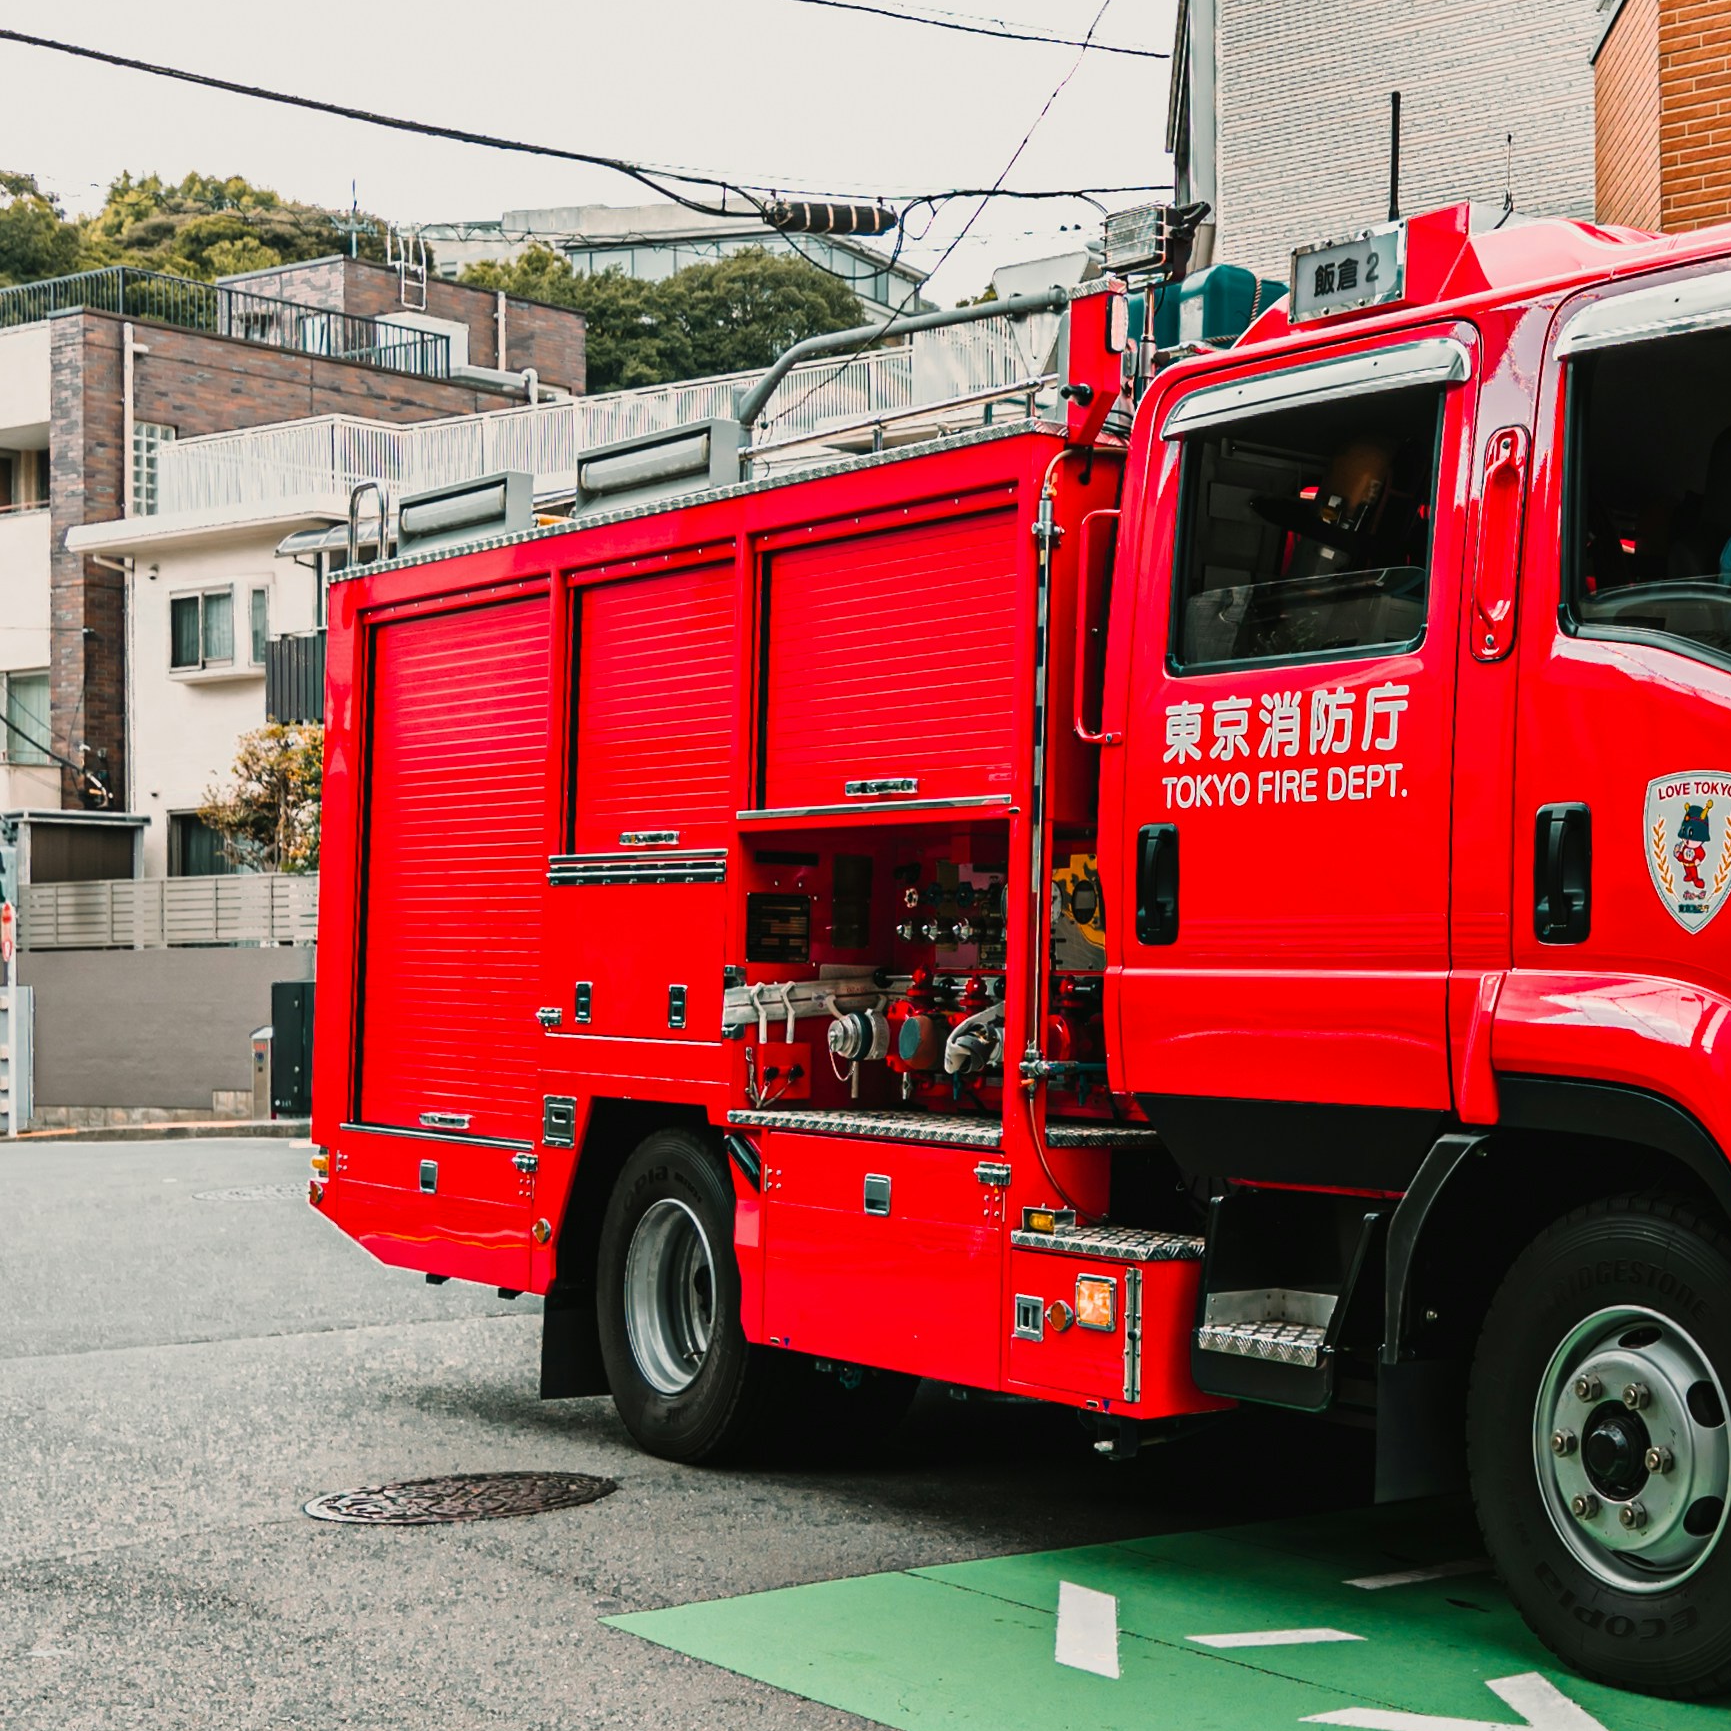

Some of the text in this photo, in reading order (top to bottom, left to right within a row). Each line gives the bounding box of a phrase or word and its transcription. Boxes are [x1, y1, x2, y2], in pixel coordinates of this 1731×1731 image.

[1162, 681, 1410, 765] 東京消防庁
[1162, 763, 1409, 809] TOKYO FIRE DEPT.
[1658, 782, 1691, 801] LOVE
